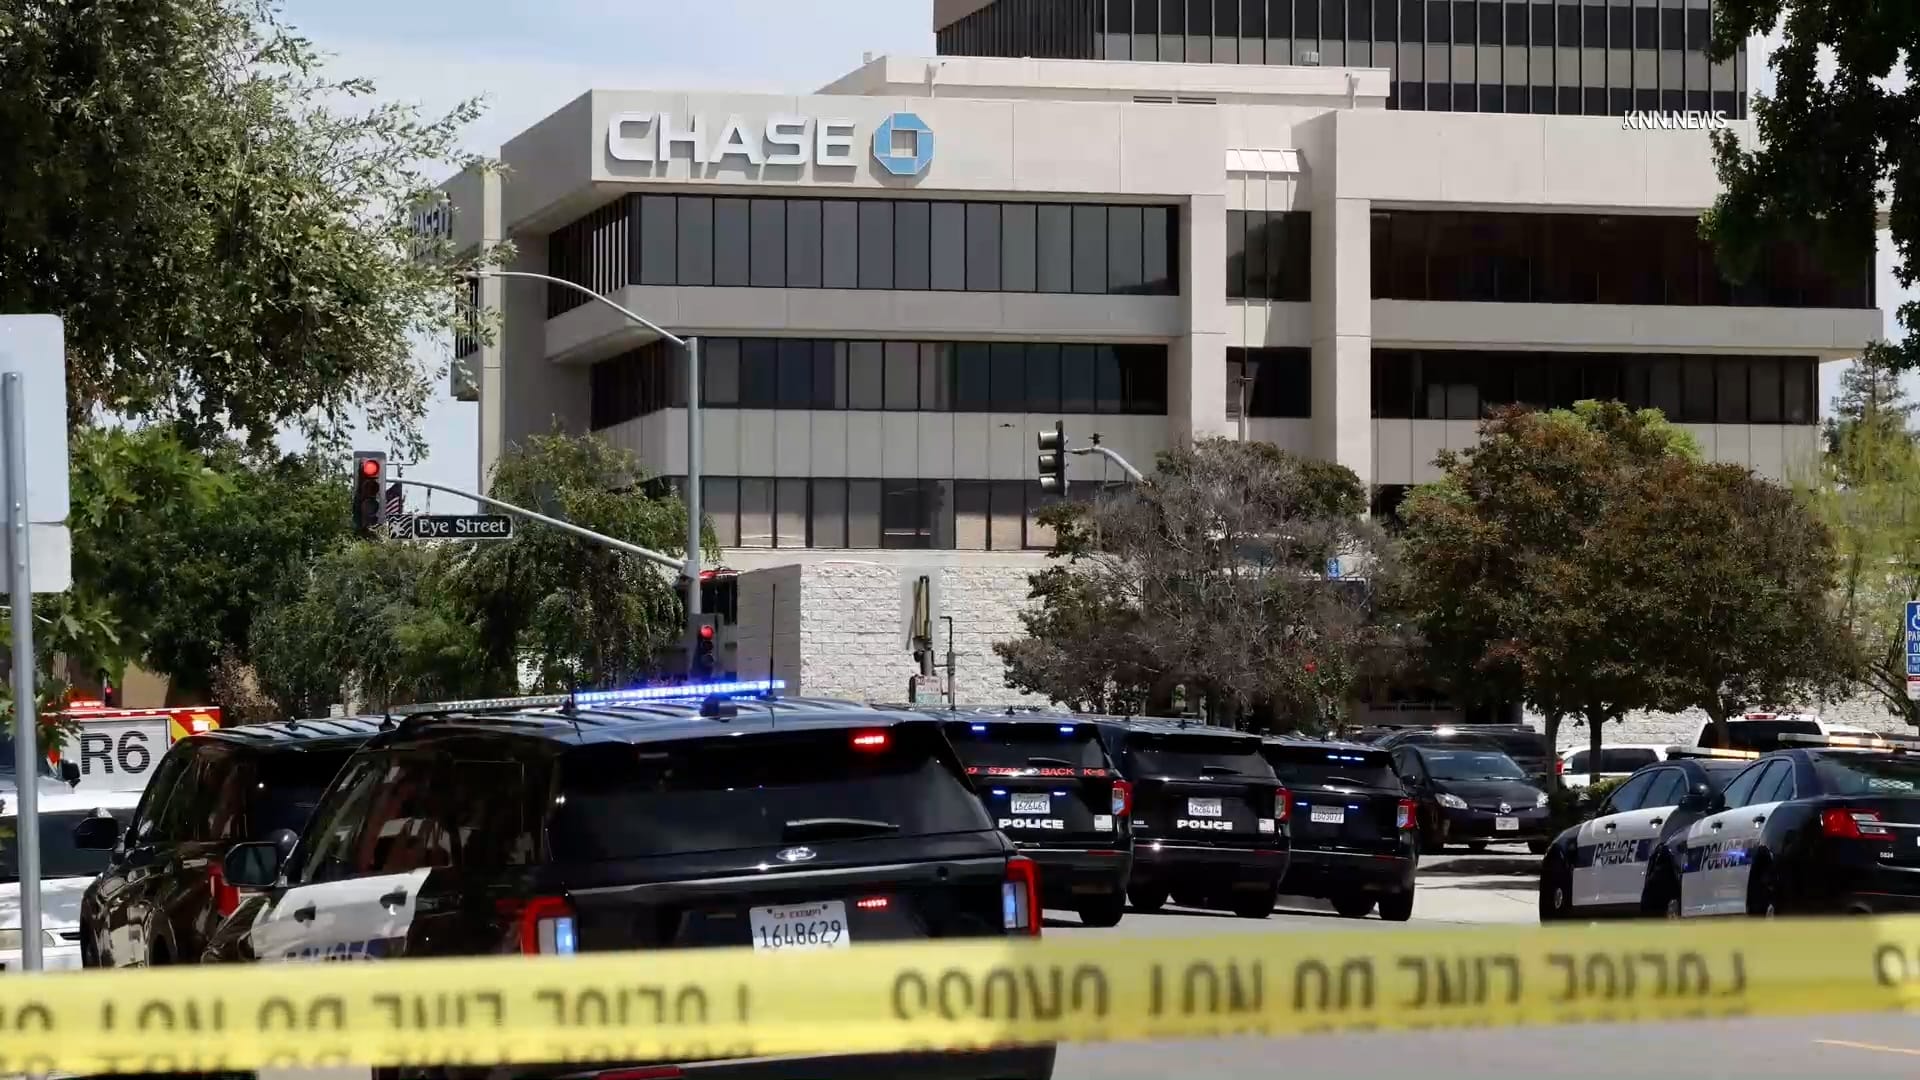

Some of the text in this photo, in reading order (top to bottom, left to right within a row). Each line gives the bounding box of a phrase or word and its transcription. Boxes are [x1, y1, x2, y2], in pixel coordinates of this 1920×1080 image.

[608, 111, 857, 167] CHASE
[419, 518, 506, 536] Eye Street
[80, 731, 151, 775] R6
[1040, 767, 1075, 776] BACK
[999, 818, 1064, 829] POLICE
[1177, 819, 1233, 830] POLICE
[760, 920, 841, 948] 1648629
